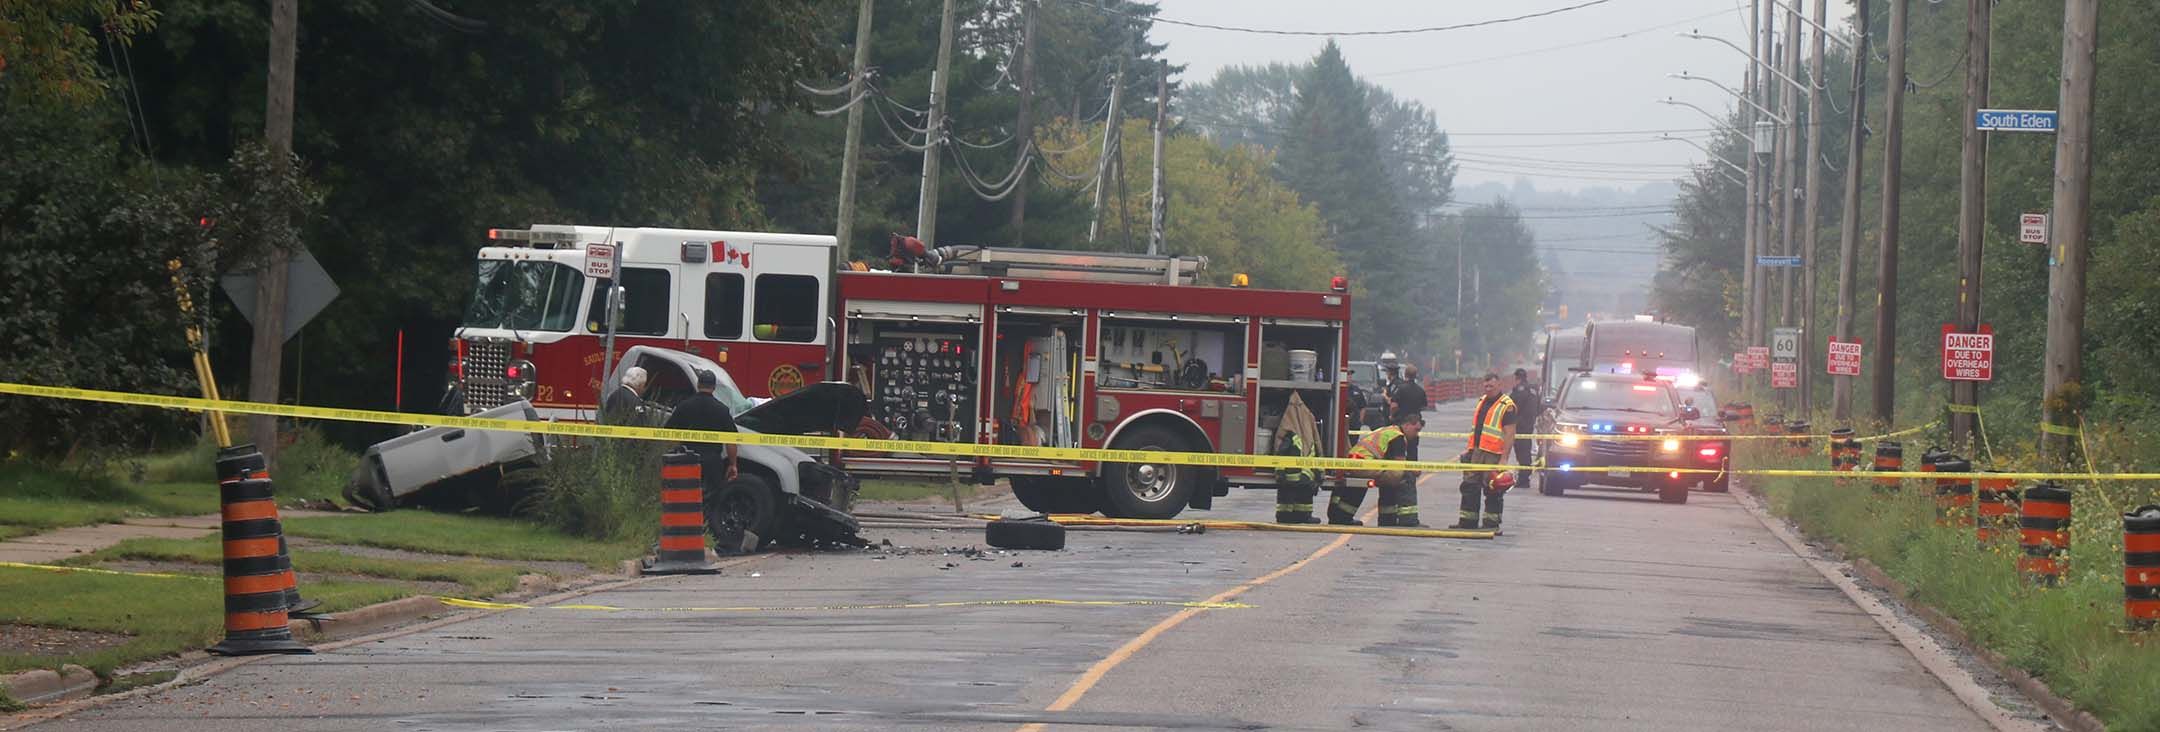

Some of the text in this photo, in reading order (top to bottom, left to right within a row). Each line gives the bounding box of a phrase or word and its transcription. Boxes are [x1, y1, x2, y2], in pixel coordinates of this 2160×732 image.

[1982, 113, 2051, 128] South Eden
[1776, 339, 1793, 351] 60
[1948, 336, 1990, 349] DANGER
[1830, 344, 1860, 353] DANGER
[1954, 350, 1982, 360] DUE TO
[1947, 359, 1989, 368] OVERHEAD
[1956, 368, 1980, 377] WIRES
[537, 385, 553, 402] P2
